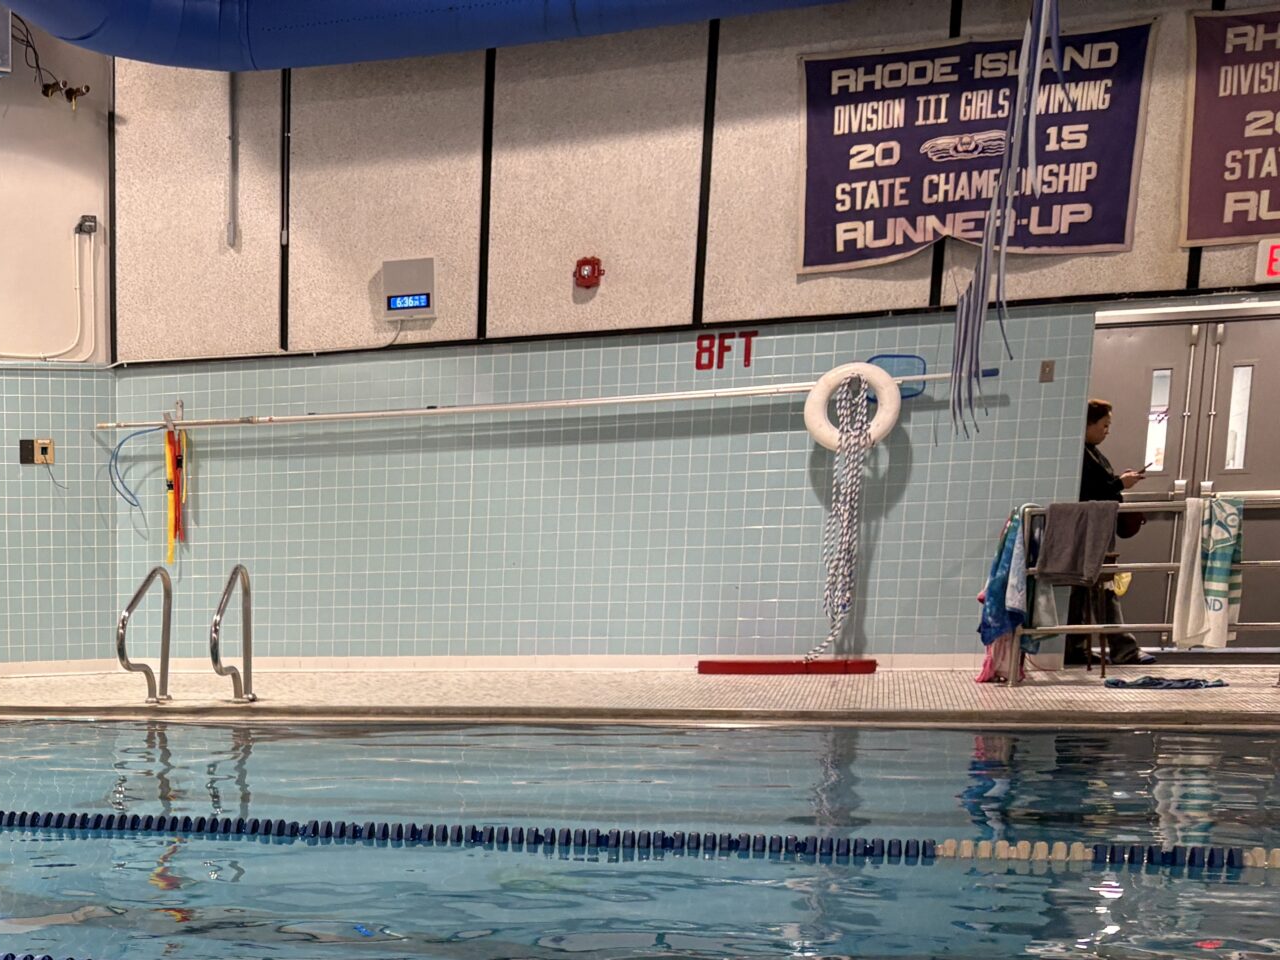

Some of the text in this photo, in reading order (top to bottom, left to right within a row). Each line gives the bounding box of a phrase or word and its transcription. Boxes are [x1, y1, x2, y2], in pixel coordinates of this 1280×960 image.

[831, 41, 1119, 95] RHODE ISLAND
[1219, 61, 1280, 97] DIVISI
[834, 78, 1112, 135] DIVISION III GIRLS WIMMING
[1244, 110, 1280, 137] 2
[849, 124, 1089, 170] 20 15
[1224, 146, 1280, 181] STA
[835, 176, 911, 212] STATE
[695, 330, 758, 370] 8FT
